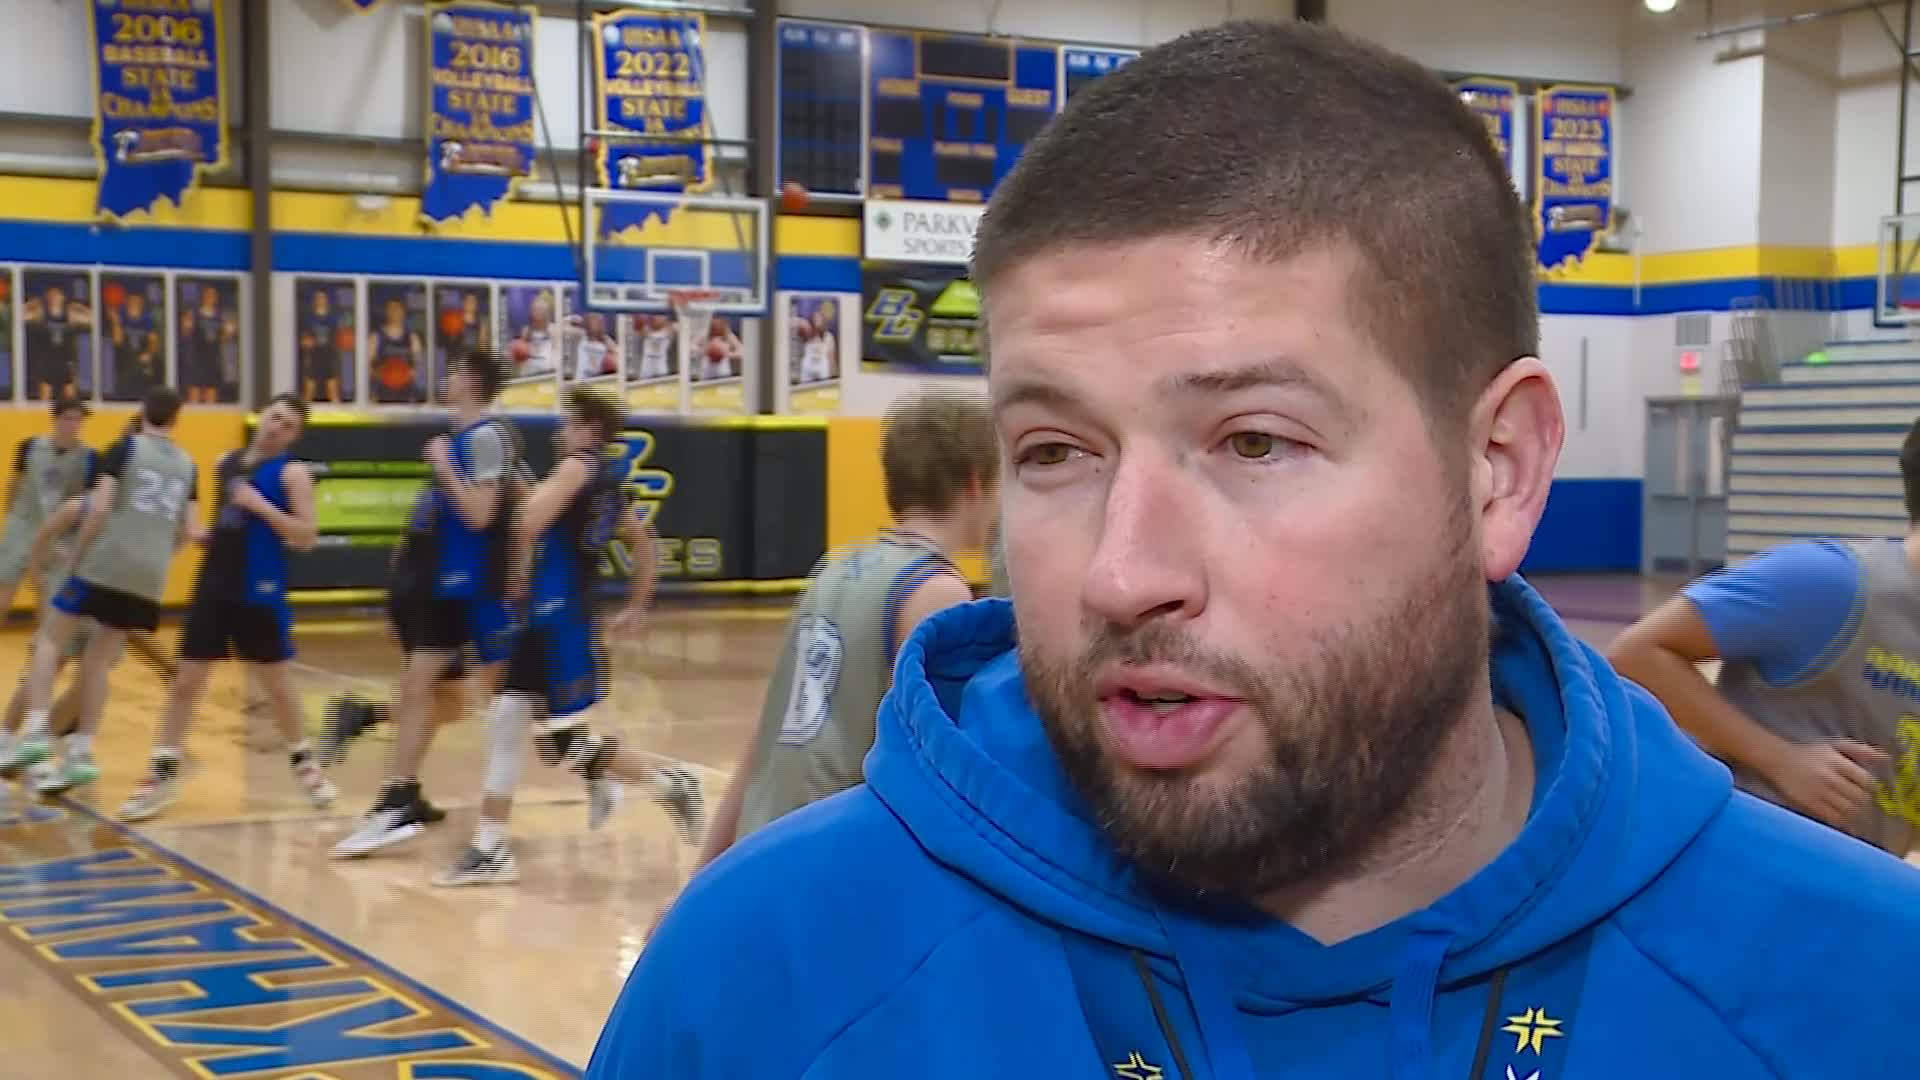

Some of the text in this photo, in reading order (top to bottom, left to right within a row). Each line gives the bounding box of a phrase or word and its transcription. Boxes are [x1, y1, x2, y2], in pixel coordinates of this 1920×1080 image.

[112, 14, 203, 44] 2006
[448, 41, 521, 70] 2016
[615, 51, 690, 77] 2022
[121, 67, 196, 88] STATE
[447, 90, 516, 114] STATE
[620, 97, 685, 119] STATE
[903, 238, 967, 256] SPORTS
